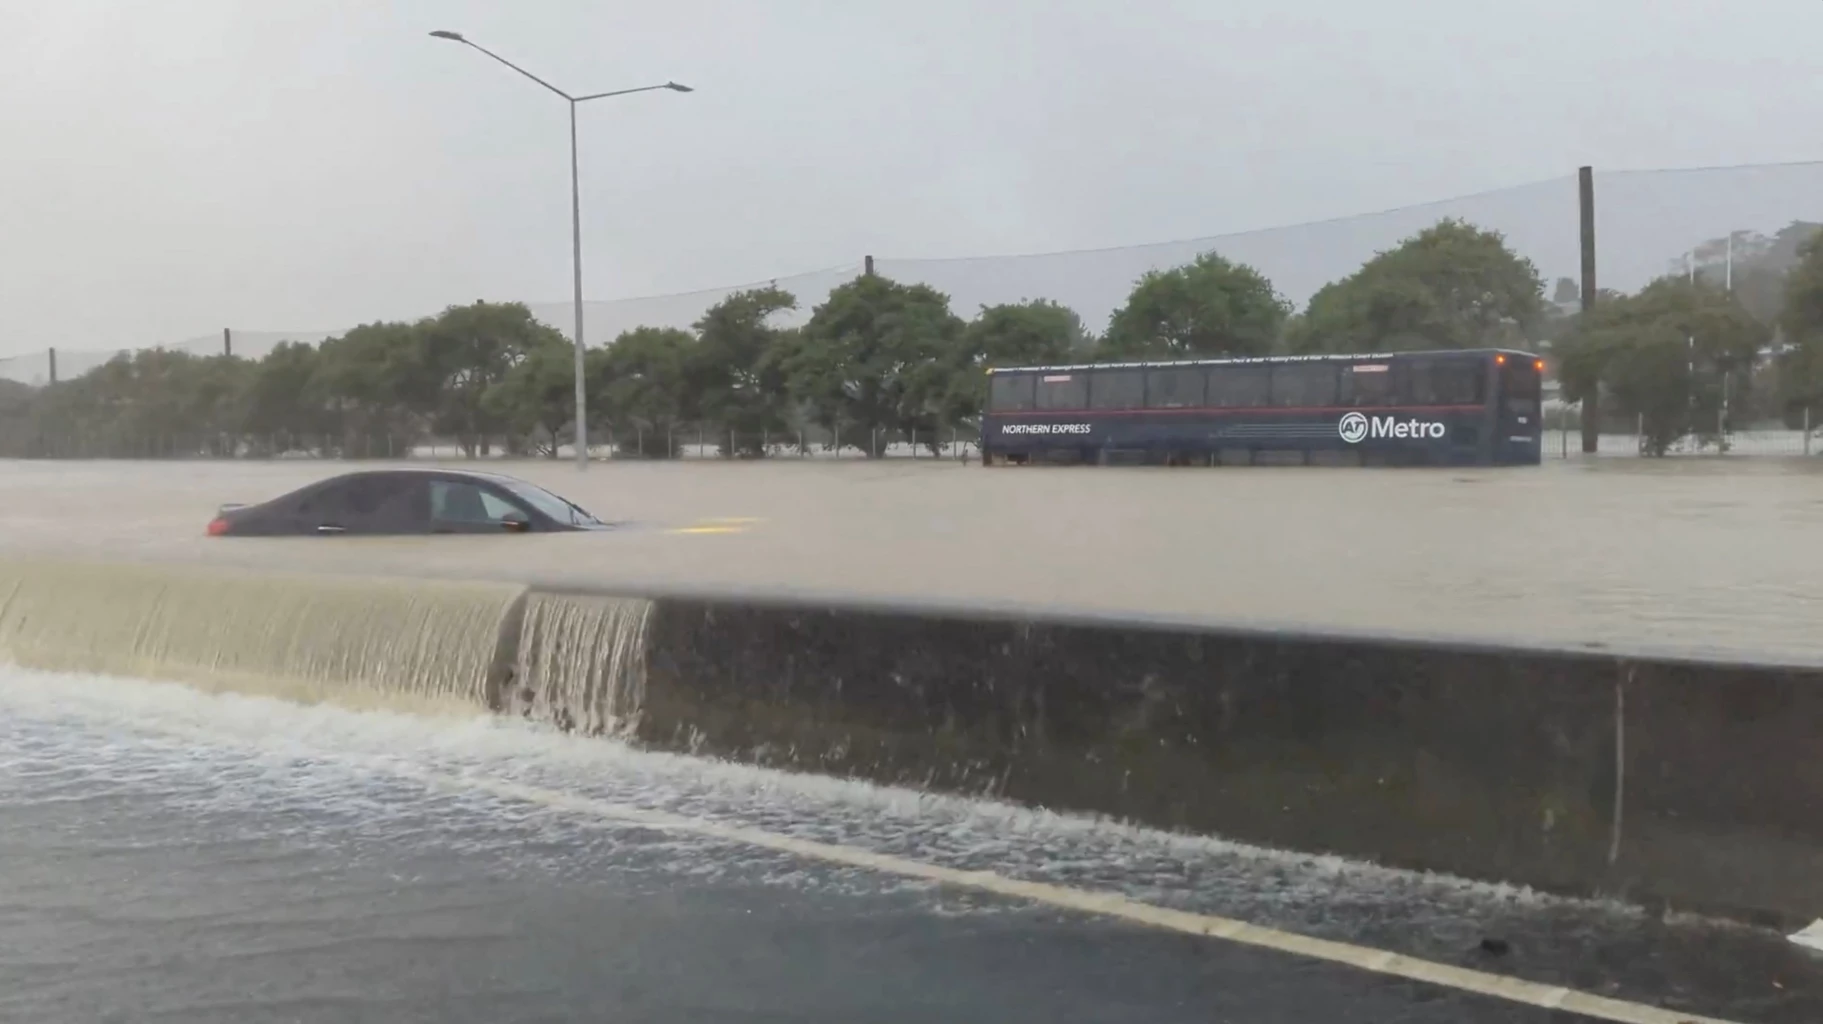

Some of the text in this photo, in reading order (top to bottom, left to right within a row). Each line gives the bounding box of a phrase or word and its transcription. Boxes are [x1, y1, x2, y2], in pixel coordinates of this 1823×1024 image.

[1002, 423, 1091, 434] NORTHERN EXPRESS
[1371, 416, 1445, 438] Metro
